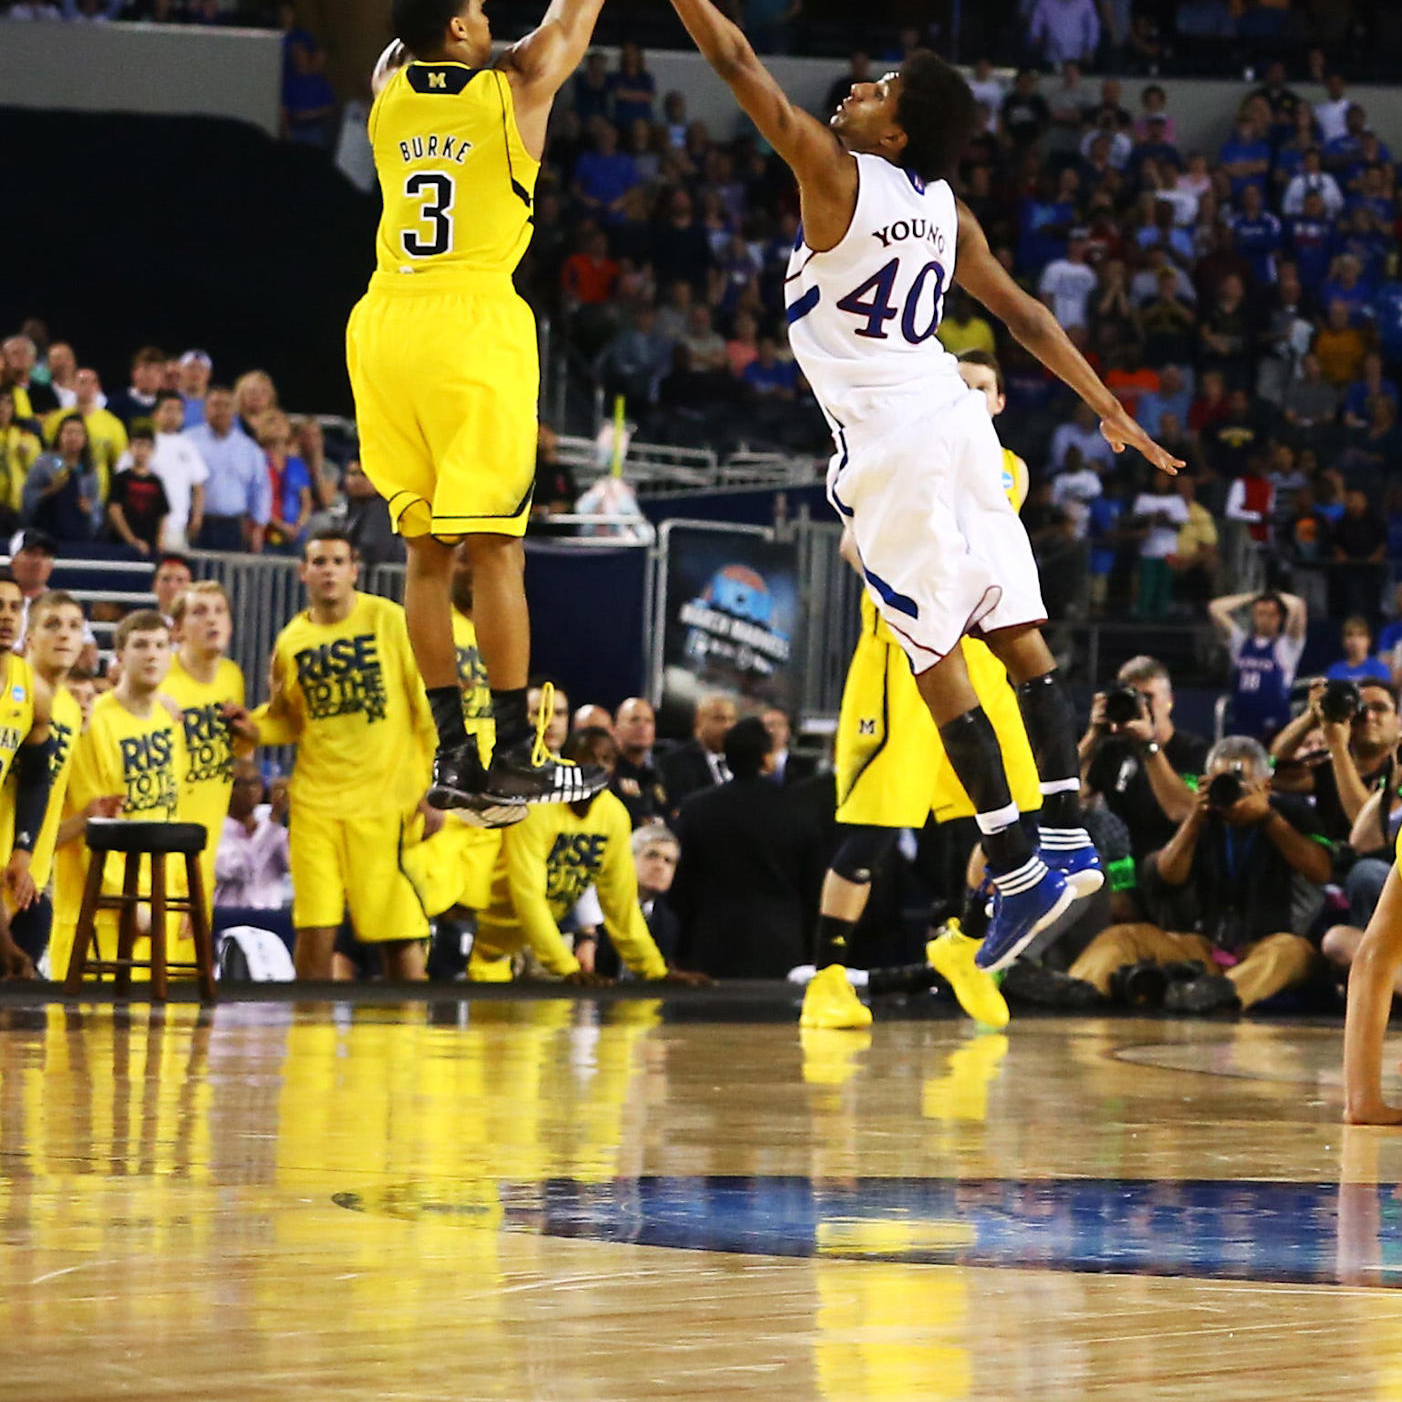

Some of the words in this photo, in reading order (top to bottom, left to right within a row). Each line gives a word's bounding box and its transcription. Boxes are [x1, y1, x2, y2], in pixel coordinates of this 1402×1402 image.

[428, 72, 447, 89] M
[399, 135, 473, 164] BURKE
[402, 171, 455, 259] 3
[836, 257, 945, 345] 40
[294, 634, 380, 684] RISE
[182, 702, 232, 746] RIS
[859, 718, 875, 735] M
